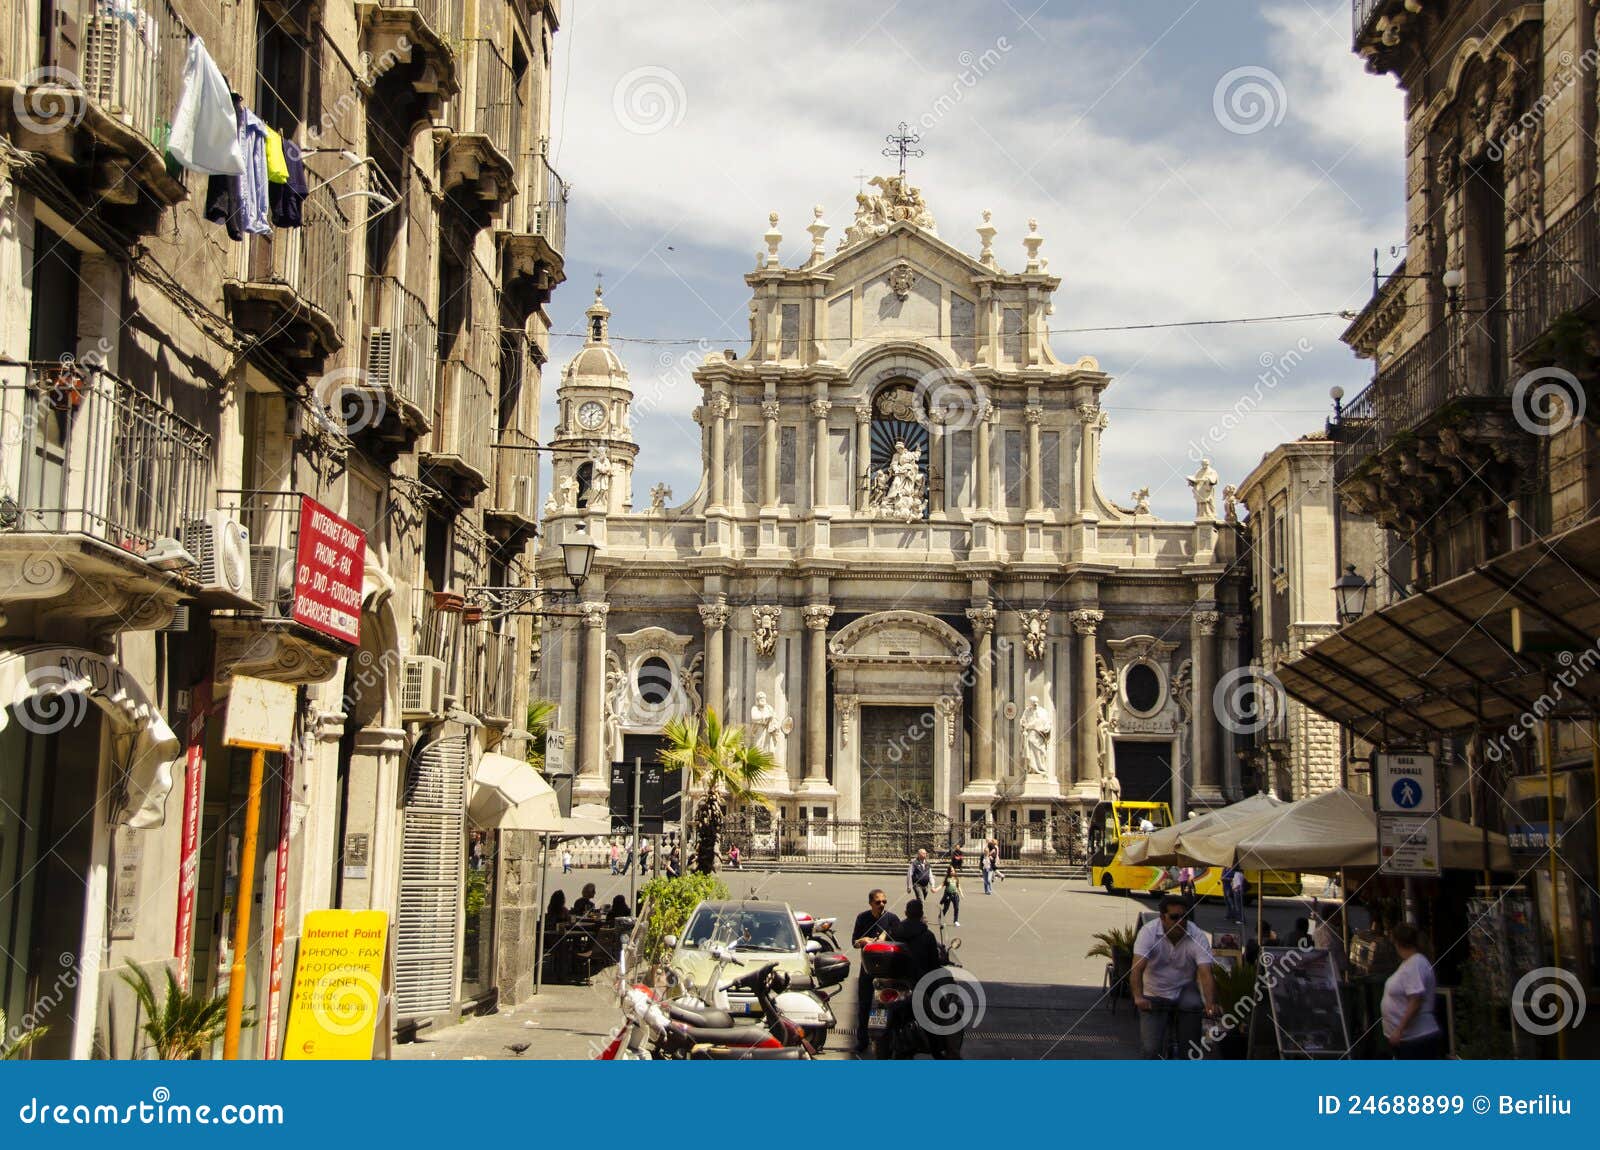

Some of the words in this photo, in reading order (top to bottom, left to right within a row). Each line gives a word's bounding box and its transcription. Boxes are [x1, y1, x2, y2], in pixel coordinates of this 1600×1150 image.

[311, 510, 340, 541] INTERNET
[340, 528, 360, 552] POINT
[315, 542, 337, 568] PHONE
[340, 555, 353, 576] FAX
[313, 572, 328, 593] DVD
[331, 580, 362, 609] FOTOCOPIE
[307, 928, 348, 939] Internet
[353, 928, 382, 938] Point
[308, 947, 348, 957] PHONO
[358, 948, 381, 957] FAX
[306, 962, 371, 972] FOTOCOPIE
[304, 978, 358, 987] INTERNET
